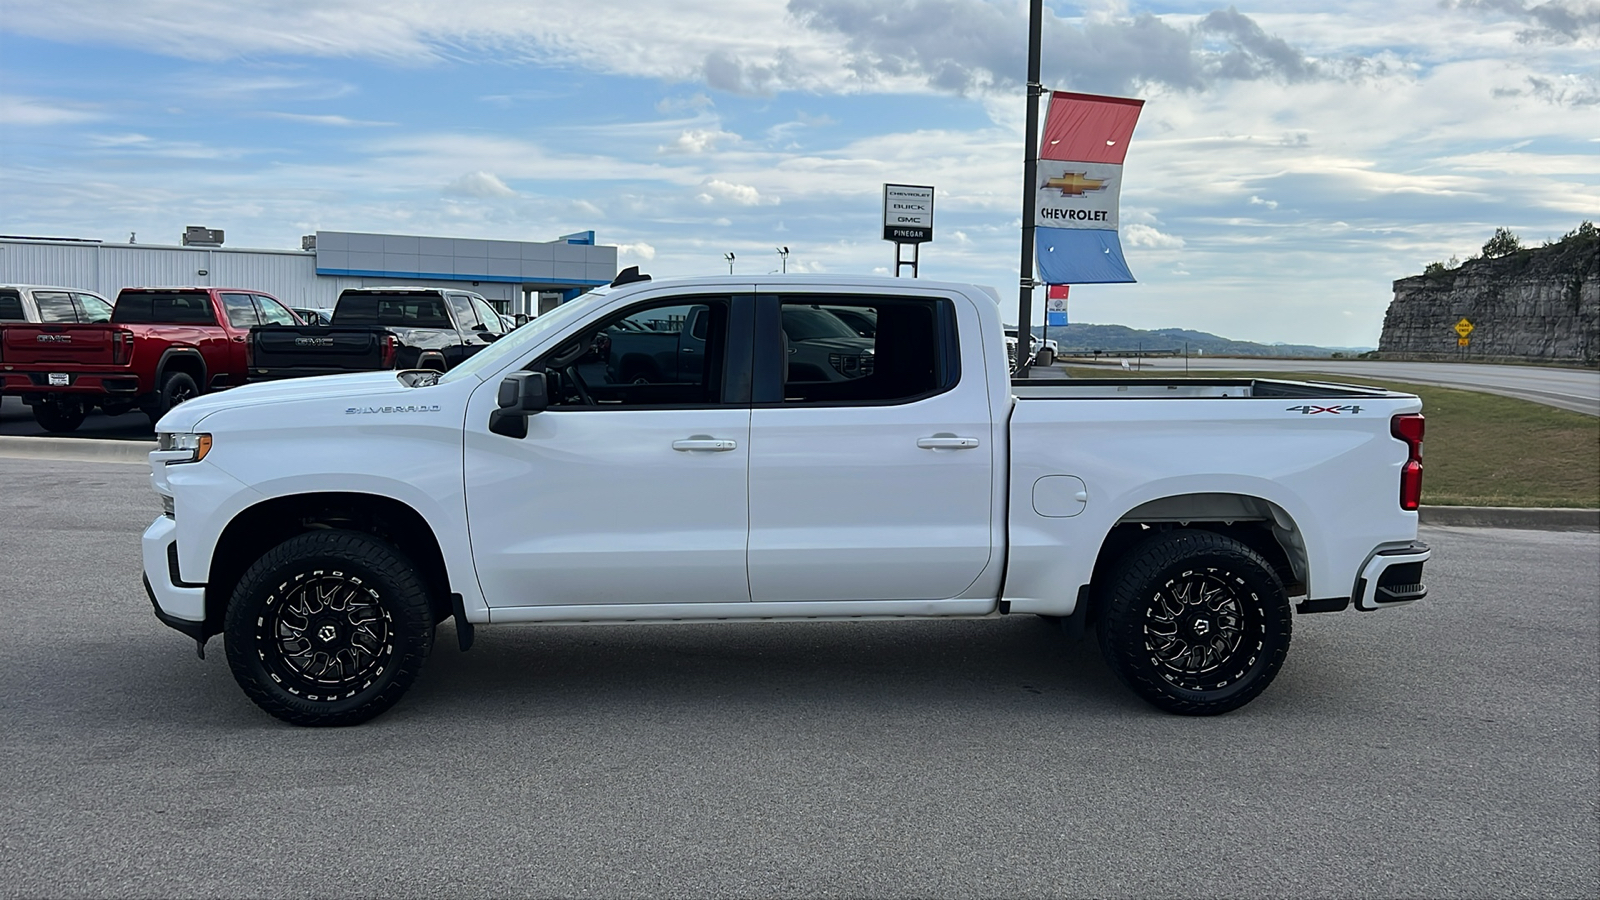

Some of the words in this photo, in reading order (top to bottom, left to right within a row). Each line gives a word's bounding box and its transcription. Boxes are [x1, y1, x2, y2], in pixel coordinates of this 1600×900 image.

[1041, 208, 1108, 221] CHEVROLET
[37, 334, 71, 342] GMC
[295, 338, 334, 346] GMC
[346, 405, 442, 414] SILVERADO
